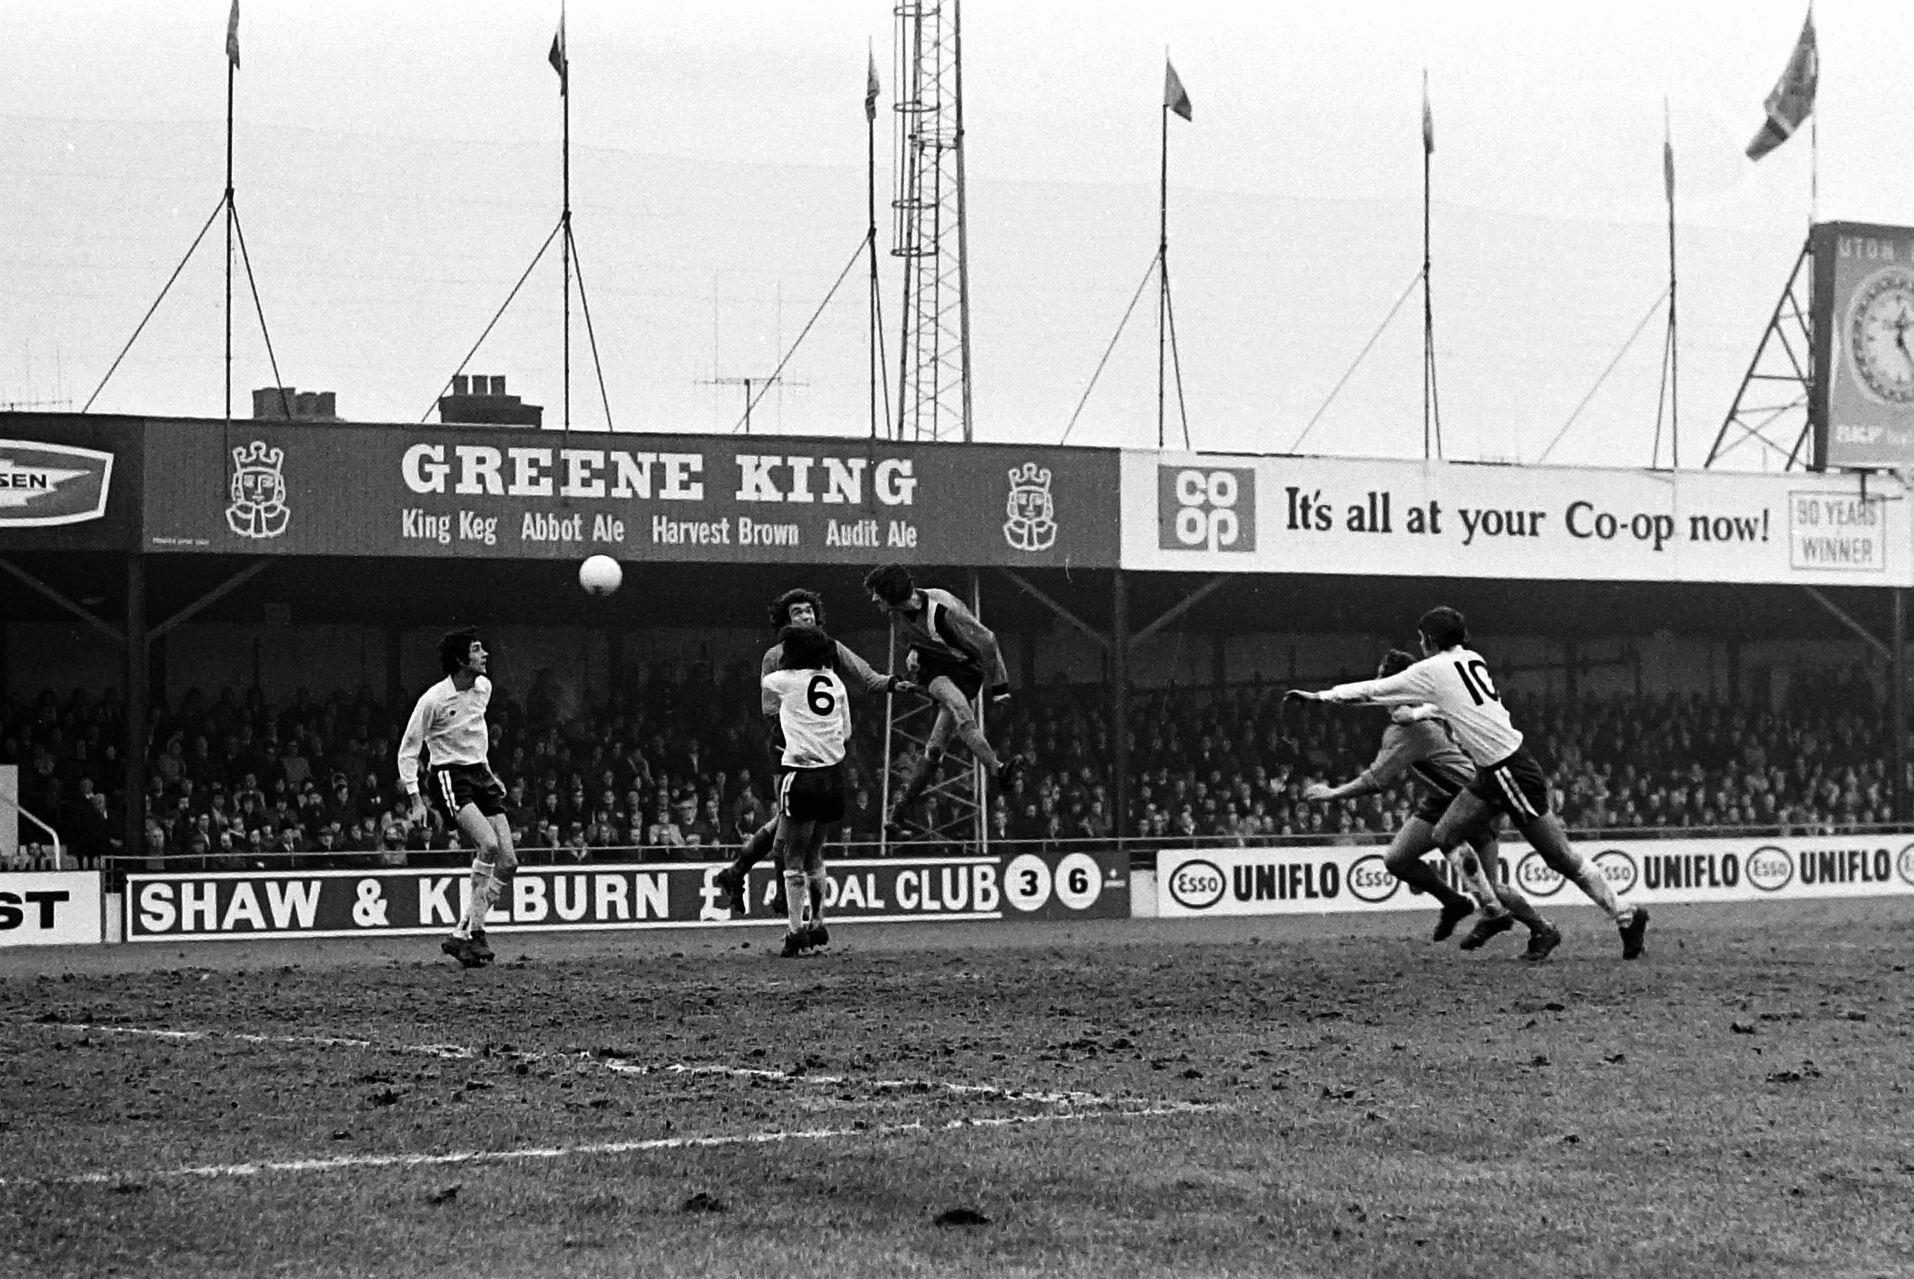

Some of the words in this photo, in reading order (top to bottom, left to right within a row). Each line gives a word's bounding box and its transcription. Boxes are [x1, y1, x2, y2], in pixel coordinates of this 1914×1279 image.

[402, 444, 703, 500] GREENE
[736, 455, 917, 505] KING
[402, 509, 451, 541] King
[460, 511, 497, 544] Keg
[521, 513, 583, 541] Abbot
[593, 514, 625, 541] Ale
[653, 515, 730, 544] Harvest
[738, 517, 798, 545] Brown
[826, 519, 879, 547] Audit
[887, 520, 917, 548] Ale
[1286, 487, 1332, 530] It's
[1346, 492, 1392, 533] all
[1407, 501, 1441, 534] at
[1458, 509, 1546, 546] your
[1565, 501, 1674, 551] Co-op
[1690, 509, 1769, 542] now!
[1825, 500, 1876, 526] YEARS
[1803, 537, 1872, 563] WINNER
[807, 675, 836, 716] 6
[1454, 660, 1499, 706] 10
[1177, 873, 1218, 894] Esso
[1233, 861, 1339, 902] UNIFLO
[1355, 868, 1393, 888] Esso
[1644, 854, 1739, 890] UNIFLO
[1799, 848, 1891, 884] UNIFLO
[139, 880, 322, 932] SHAW
[352, 878, 390, 926] &
[895, 864, 1000, 912] CLUB
